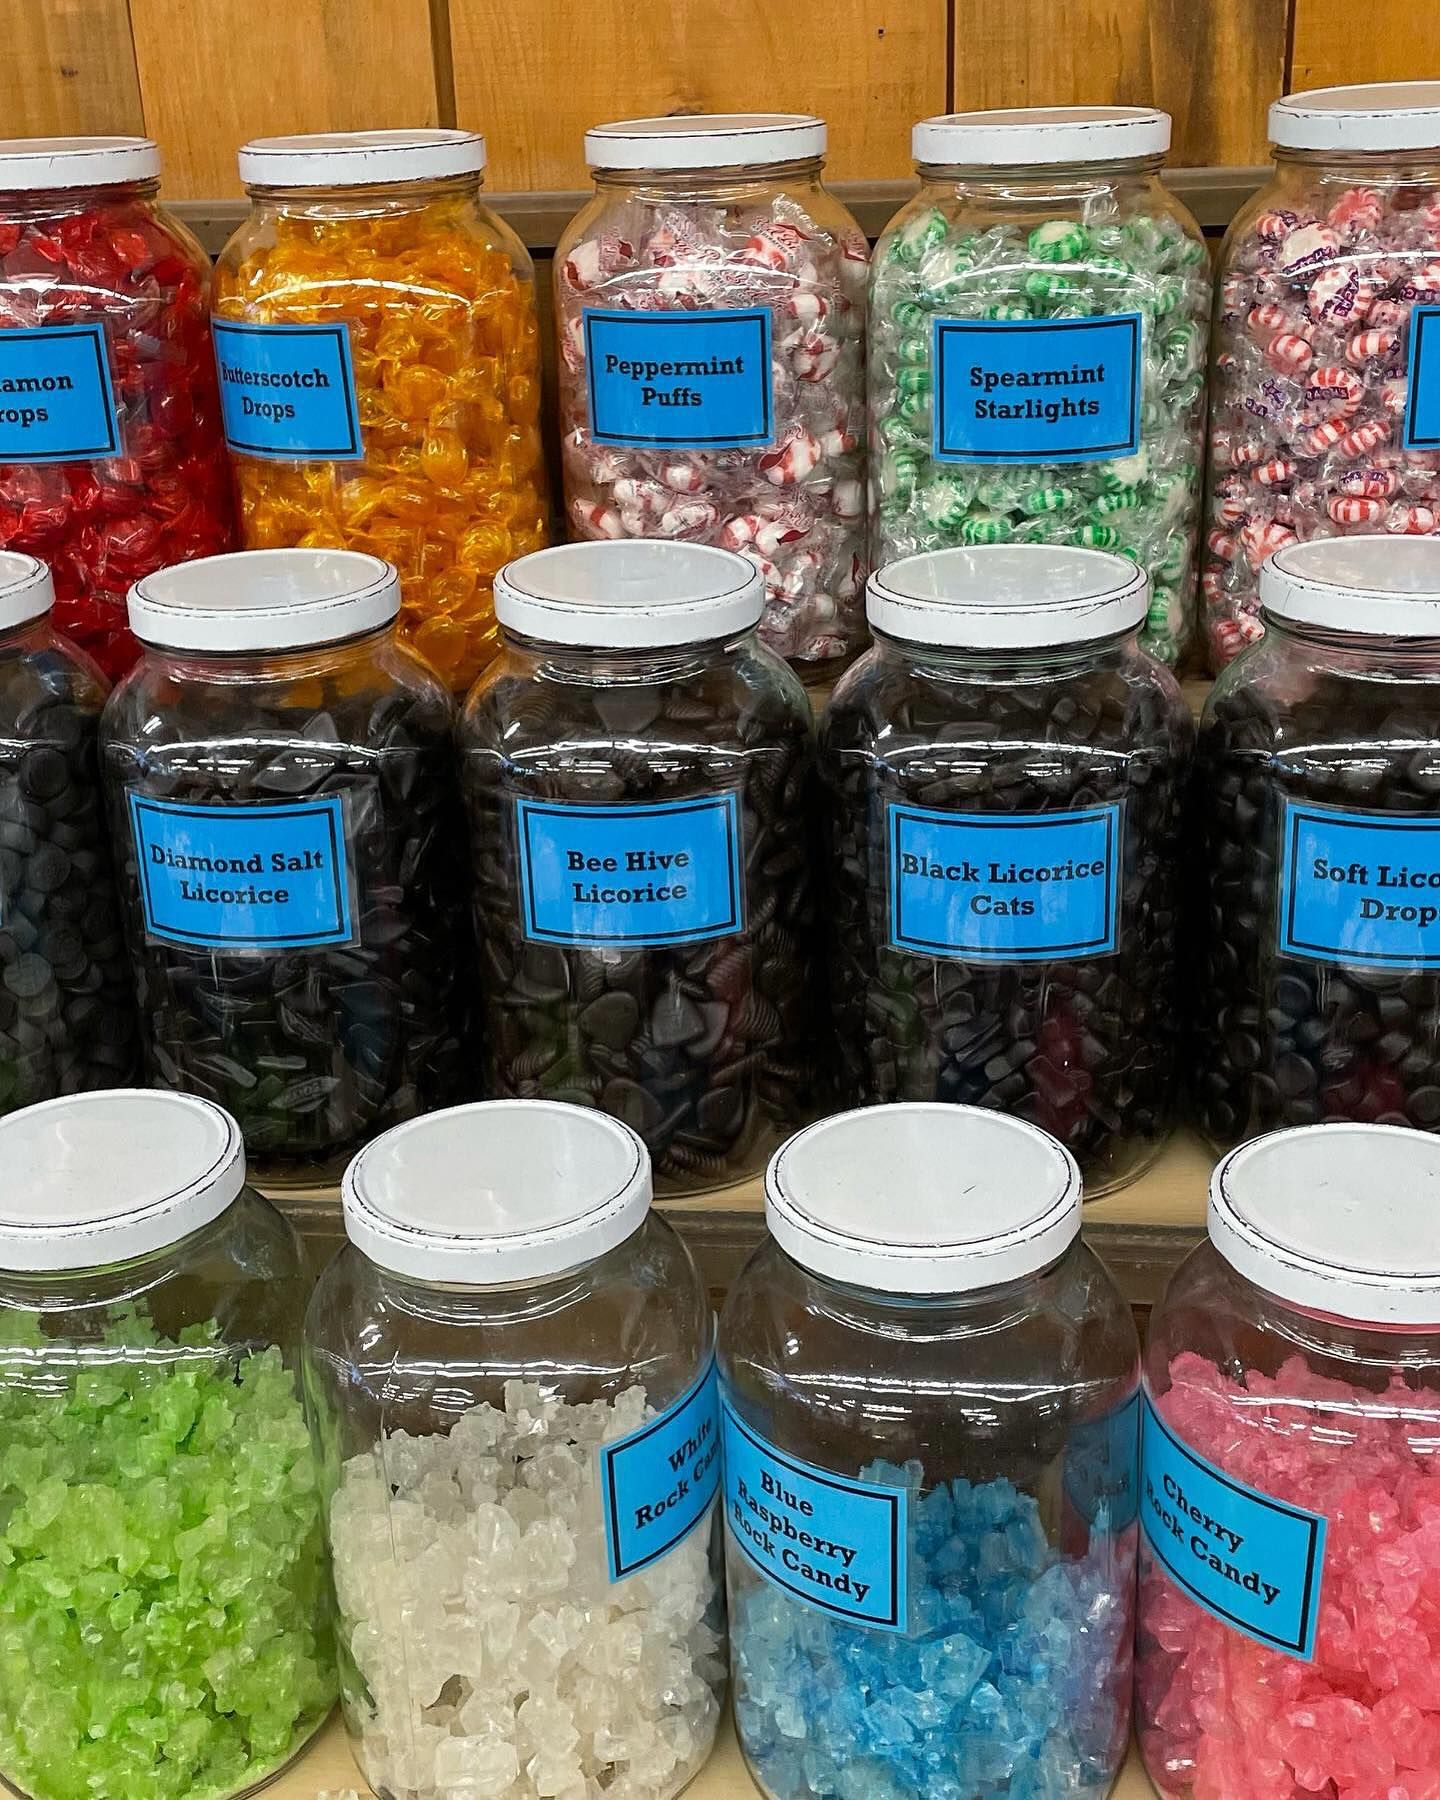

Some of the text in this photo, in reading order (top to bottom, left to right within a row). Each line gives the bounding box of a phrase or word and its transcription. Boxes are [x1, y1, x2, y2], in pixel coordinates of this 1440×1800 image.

[221, 361, 330, 388] Butterscotch
[605, 354, 745, 381] Peppermint
[969, 363, 1105, 393] Spearmint
[0, 375, 74, 393] amon
[641, 387, 703, 407] Puffs
[241, 395, 296, 424] Drops
[974, 397, 1100, 424] Starlights
[151, 844, 323, 874] Diamond Salt
[567, 850, 689, 873] Bee Hive
[902, 853, 1105, 884] Black Licorice
[1313, 858, 1369, 886] Soft
[180, 880, 289, 905] Licorice
[572, 882, 688, 904] Licorice
[970, 895, 1035, 917] Cats
[1360, 897, 1440, 928] Drop
[634, 1480, 689, 1530] Rock
[760, 1469, 814, 1517] Blue
[737, 1477, 858, 1569] Raspberry
[1163, 1474, 1245, 1554] Cherry
[733, 1500, 871, 1603] Rock Candy
[1190, 1535, 1281, 1606] Candy
